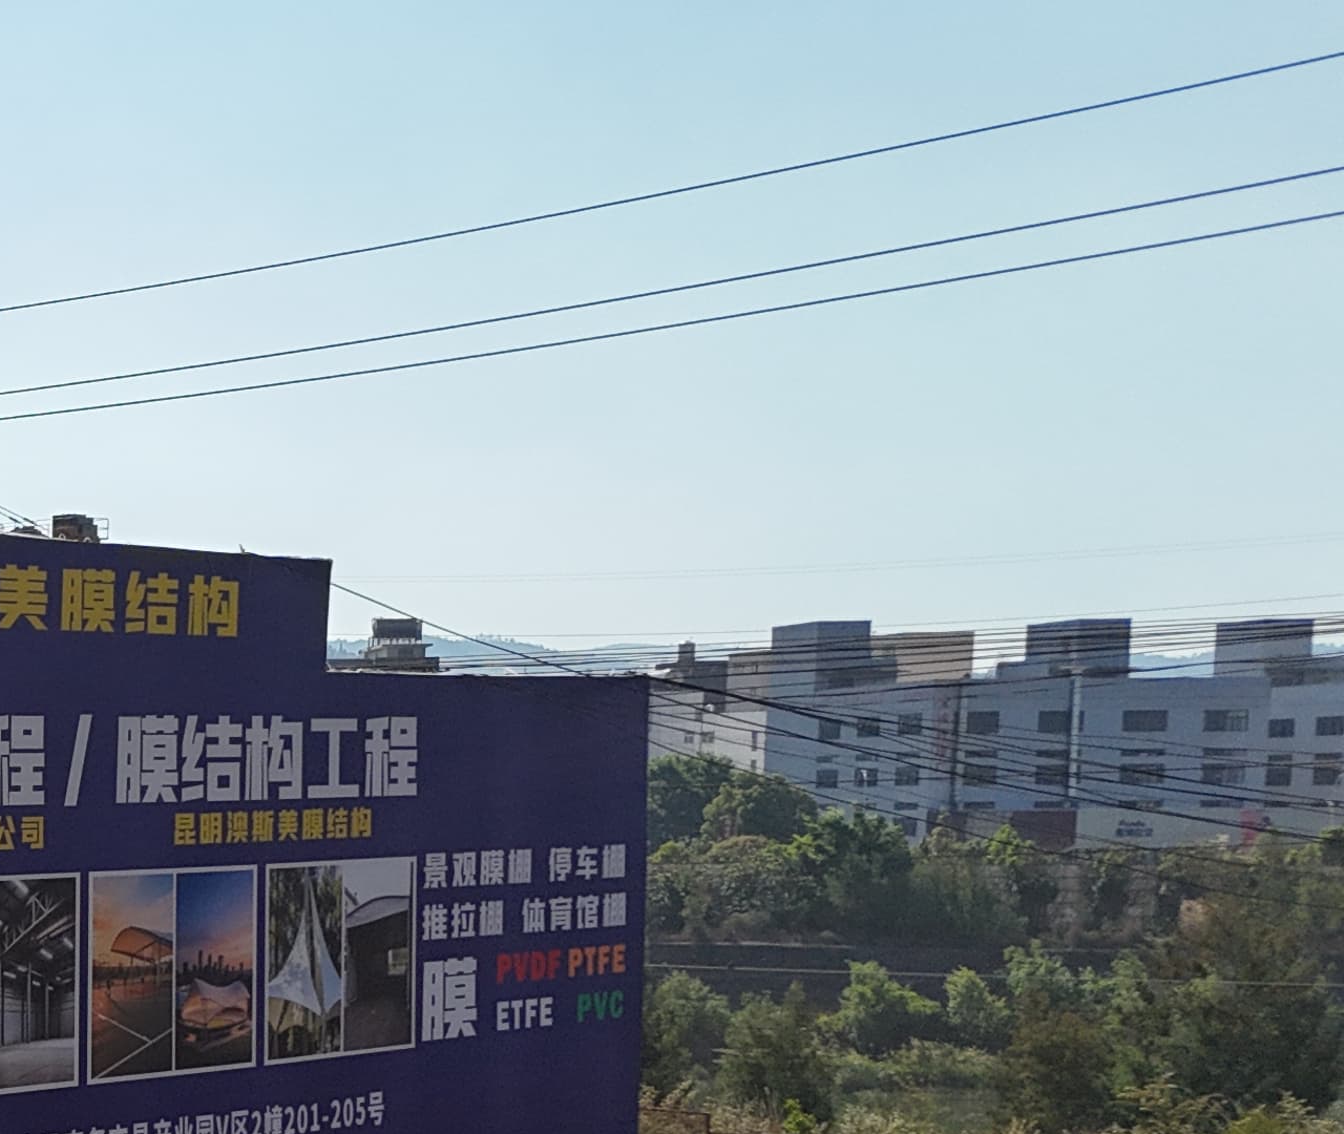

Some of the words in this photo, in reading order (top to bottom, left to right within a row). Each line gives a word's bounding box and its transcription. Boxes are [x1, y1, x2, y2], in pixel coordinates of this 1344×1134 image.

[174, 807, 373, 845] 昆明澳斯美膜结构
[423, 851, 532, 889] 景观膜棚
[548, 843, 627, 881] 停车棚
[422, 899, 503, 940] 推拉棚
[521, 892, 627, 934] 体育馆棚
[496, 948, 562, 983] PVDF
[568, 942, 626, 977] PTFE
[421, 957, 478, 1042] 膜
[496, 995, 553, 1030] ETFE
[576, 989, 624, 1023] PVC
